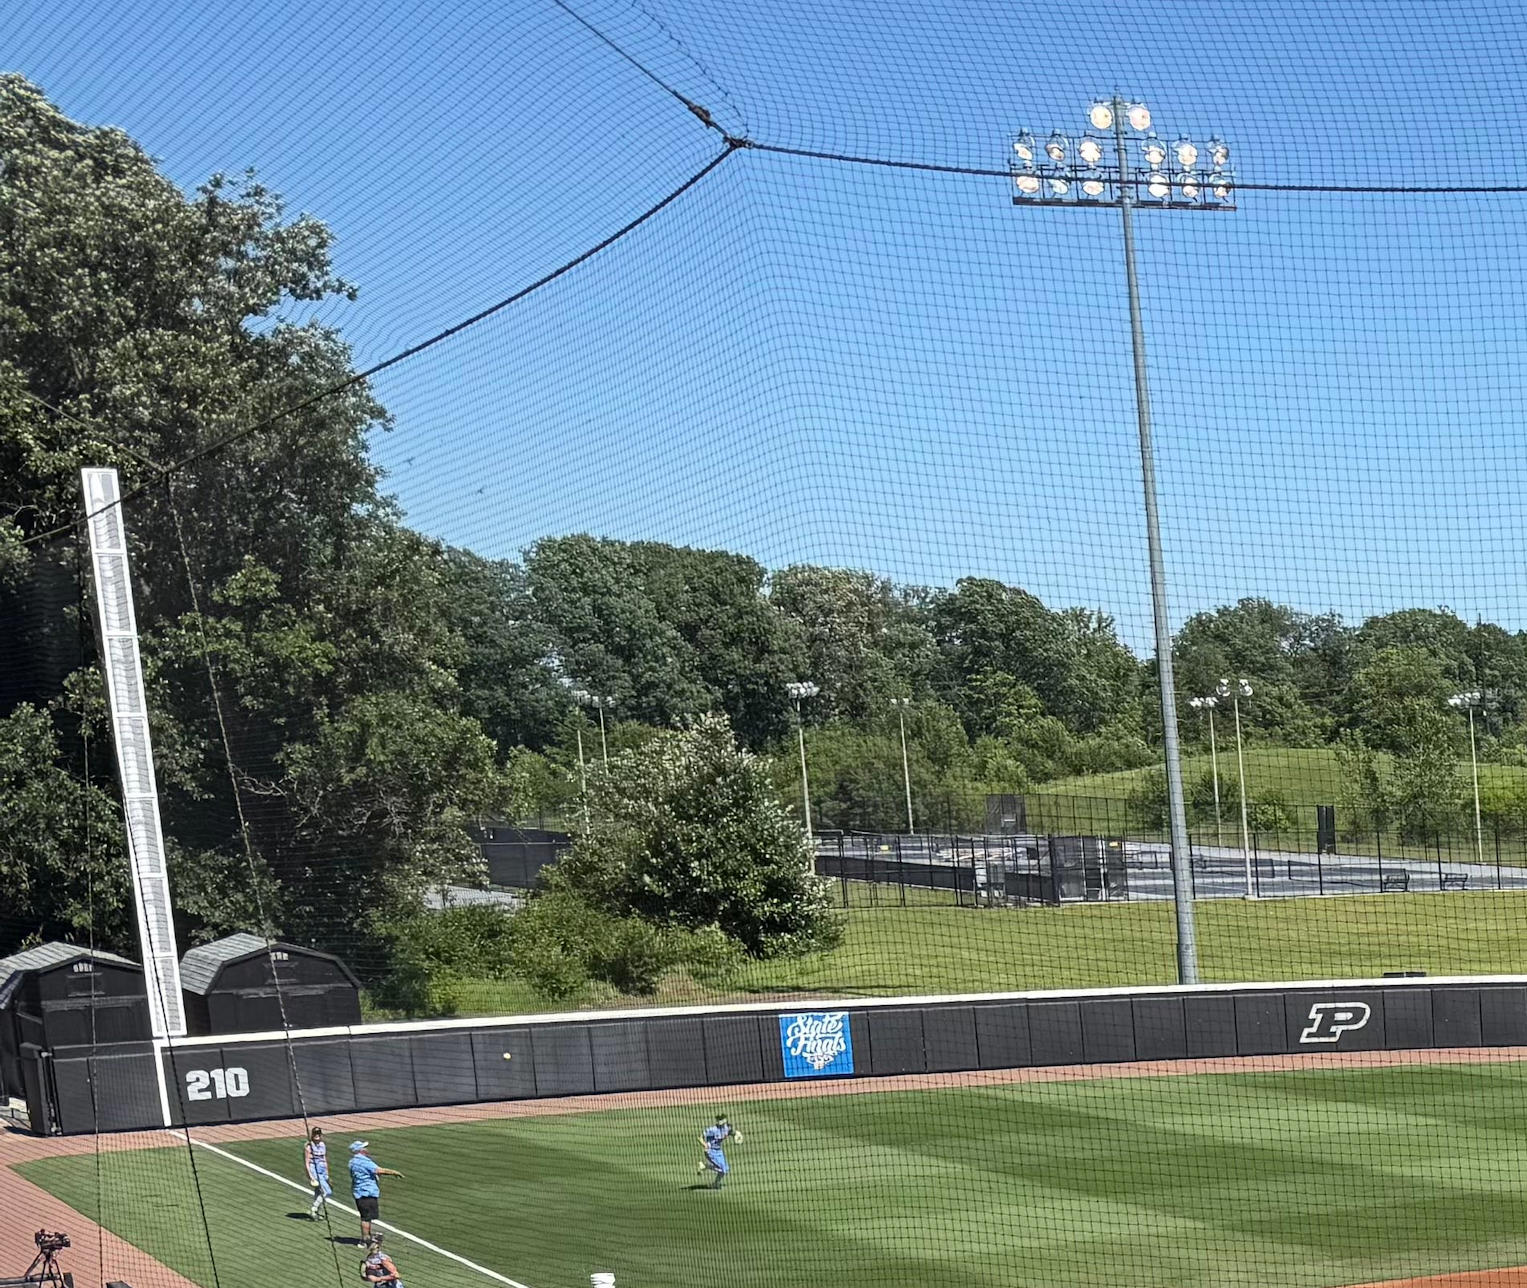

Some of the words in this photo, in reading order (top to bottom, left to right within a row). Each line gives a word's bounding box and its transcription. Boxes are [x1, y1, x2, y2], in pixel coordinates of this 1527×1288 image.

[787, 1014, 844, 1037] State
[1299, 1001, 1372, 1043] P
[786, 1032, 847, 1056] Finals
[186, 1067, 250, 1101] 210
